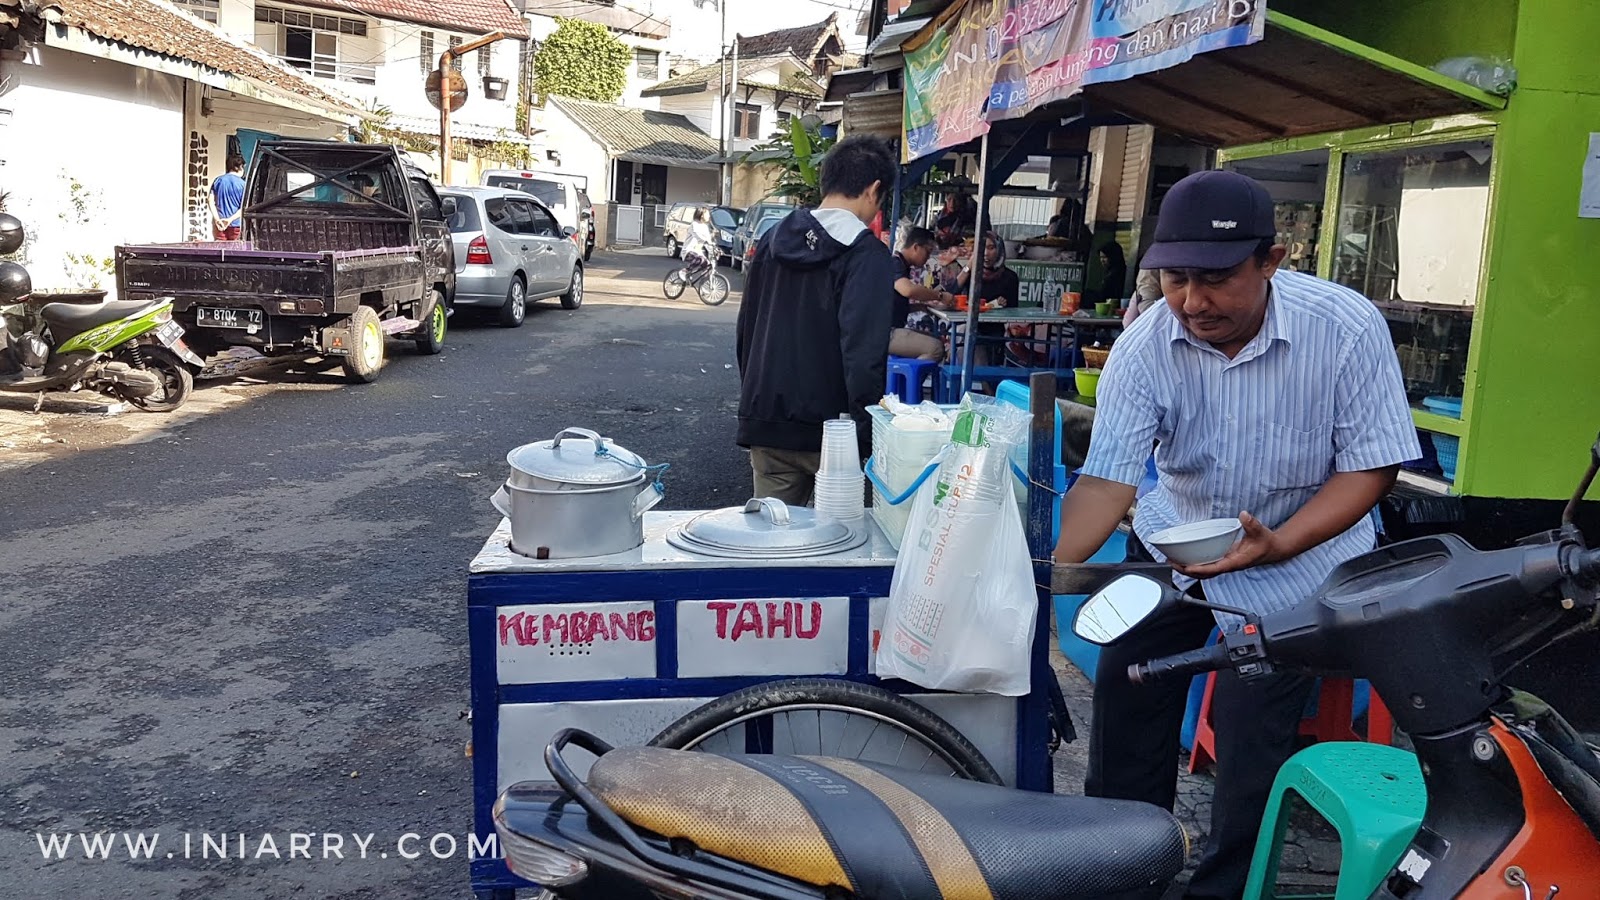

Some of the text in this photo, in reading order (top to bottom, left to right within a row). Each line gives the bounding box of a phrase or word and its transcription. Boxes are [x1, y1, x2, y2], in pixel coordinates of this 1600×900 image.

[1126, 28, 1163, 55] dan
[213, 309, 237, 321] 8704
[924, 523, 952, 587] SPESIAL
[946, 486, 962, 519] CUP
[957, 464, 972, 482] 12
[498, 601, 823, 646] KEMBANG TAHU
